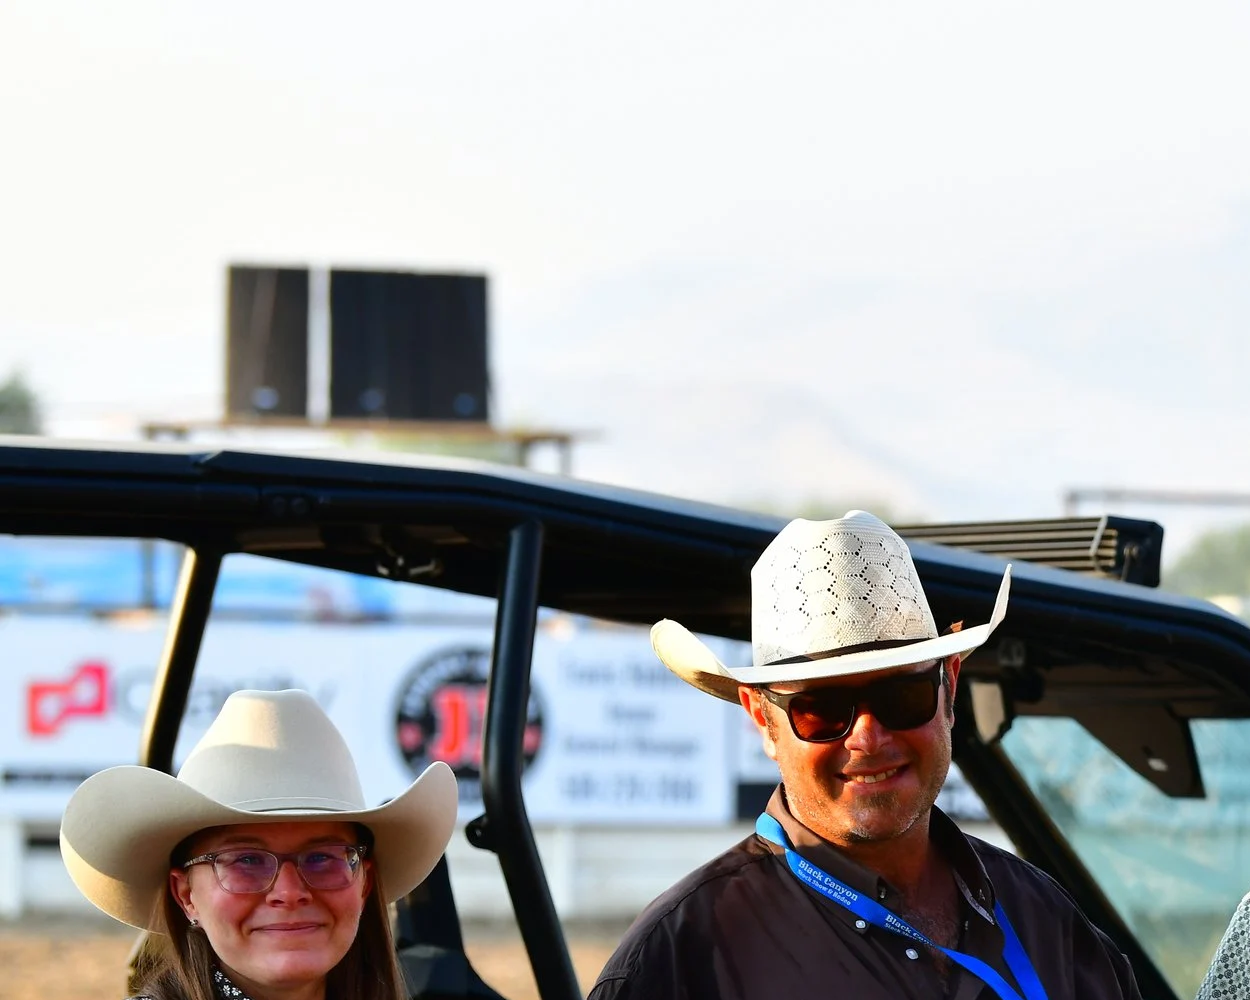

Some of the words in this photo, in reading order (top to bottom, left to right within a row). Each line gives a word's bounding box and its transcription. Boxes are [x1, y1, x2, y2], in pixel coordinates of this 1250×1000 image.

[798, 860, 824, 881] Black
[824, 877, 858, 901] Canyon
[798, 869, 812, 882] Stock
[811, 879, 828, 892] Show
[832, 891, 851, 906] Rodeo
[885, 914, 911, 934] Black
